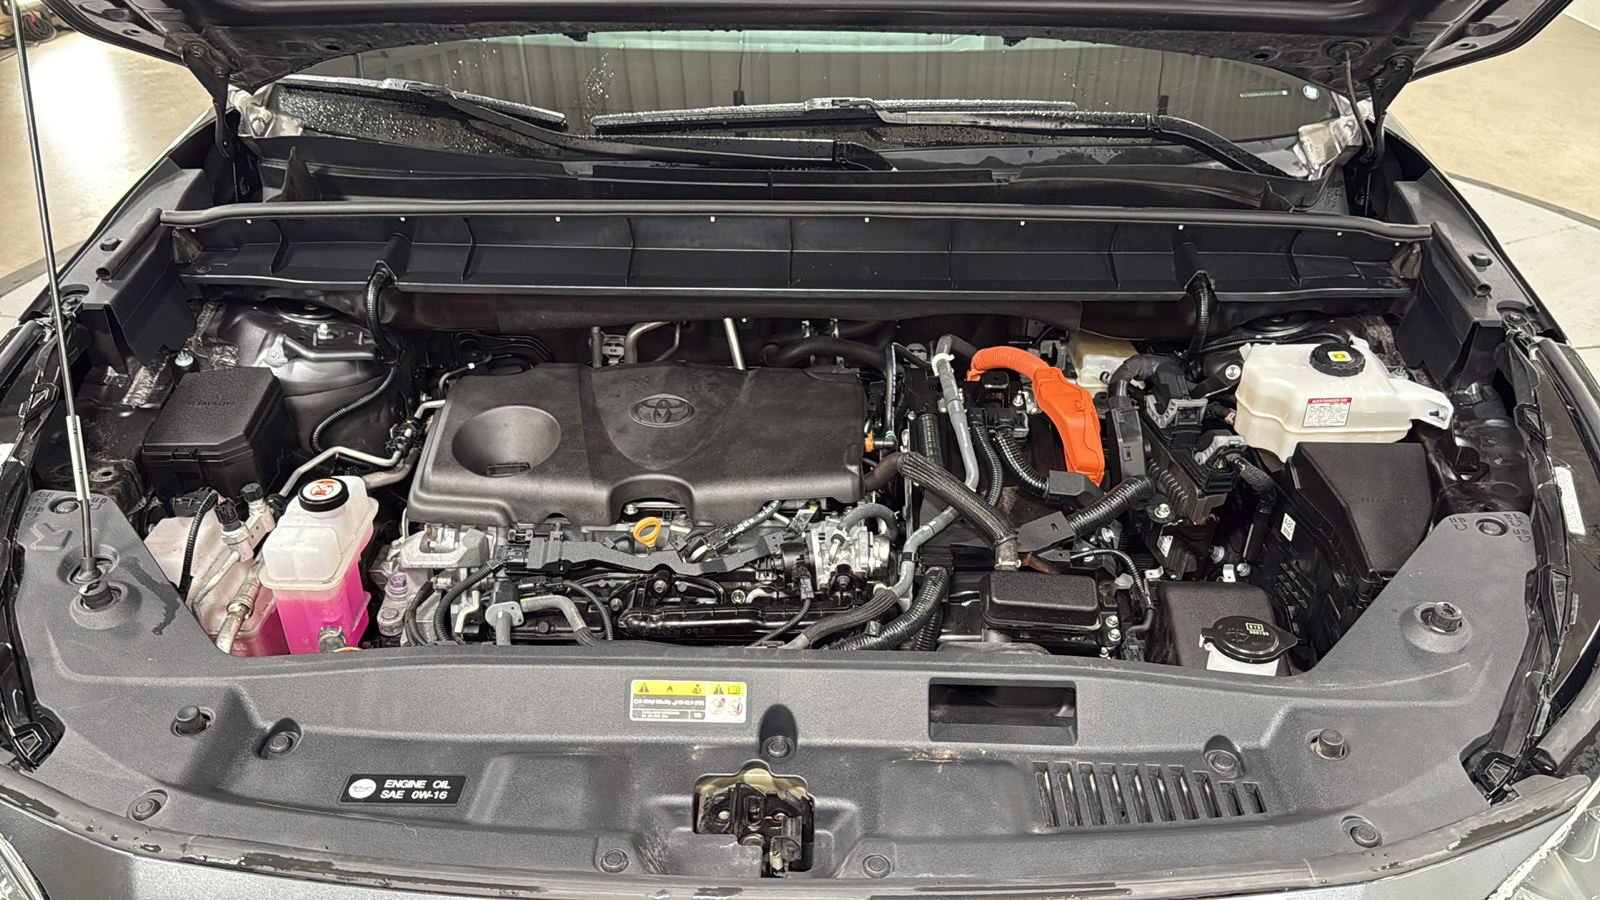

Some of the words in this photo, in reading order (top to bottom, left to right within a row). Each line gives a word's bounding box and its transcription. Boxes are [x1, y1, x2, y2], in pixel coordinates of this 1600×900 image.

[383, 779, 428, 789] ENGINE
[432, 780, 451, 789] OIL
[379, 789, 405, 799] SAE
[411, 790, 448, 799] 0W-16
